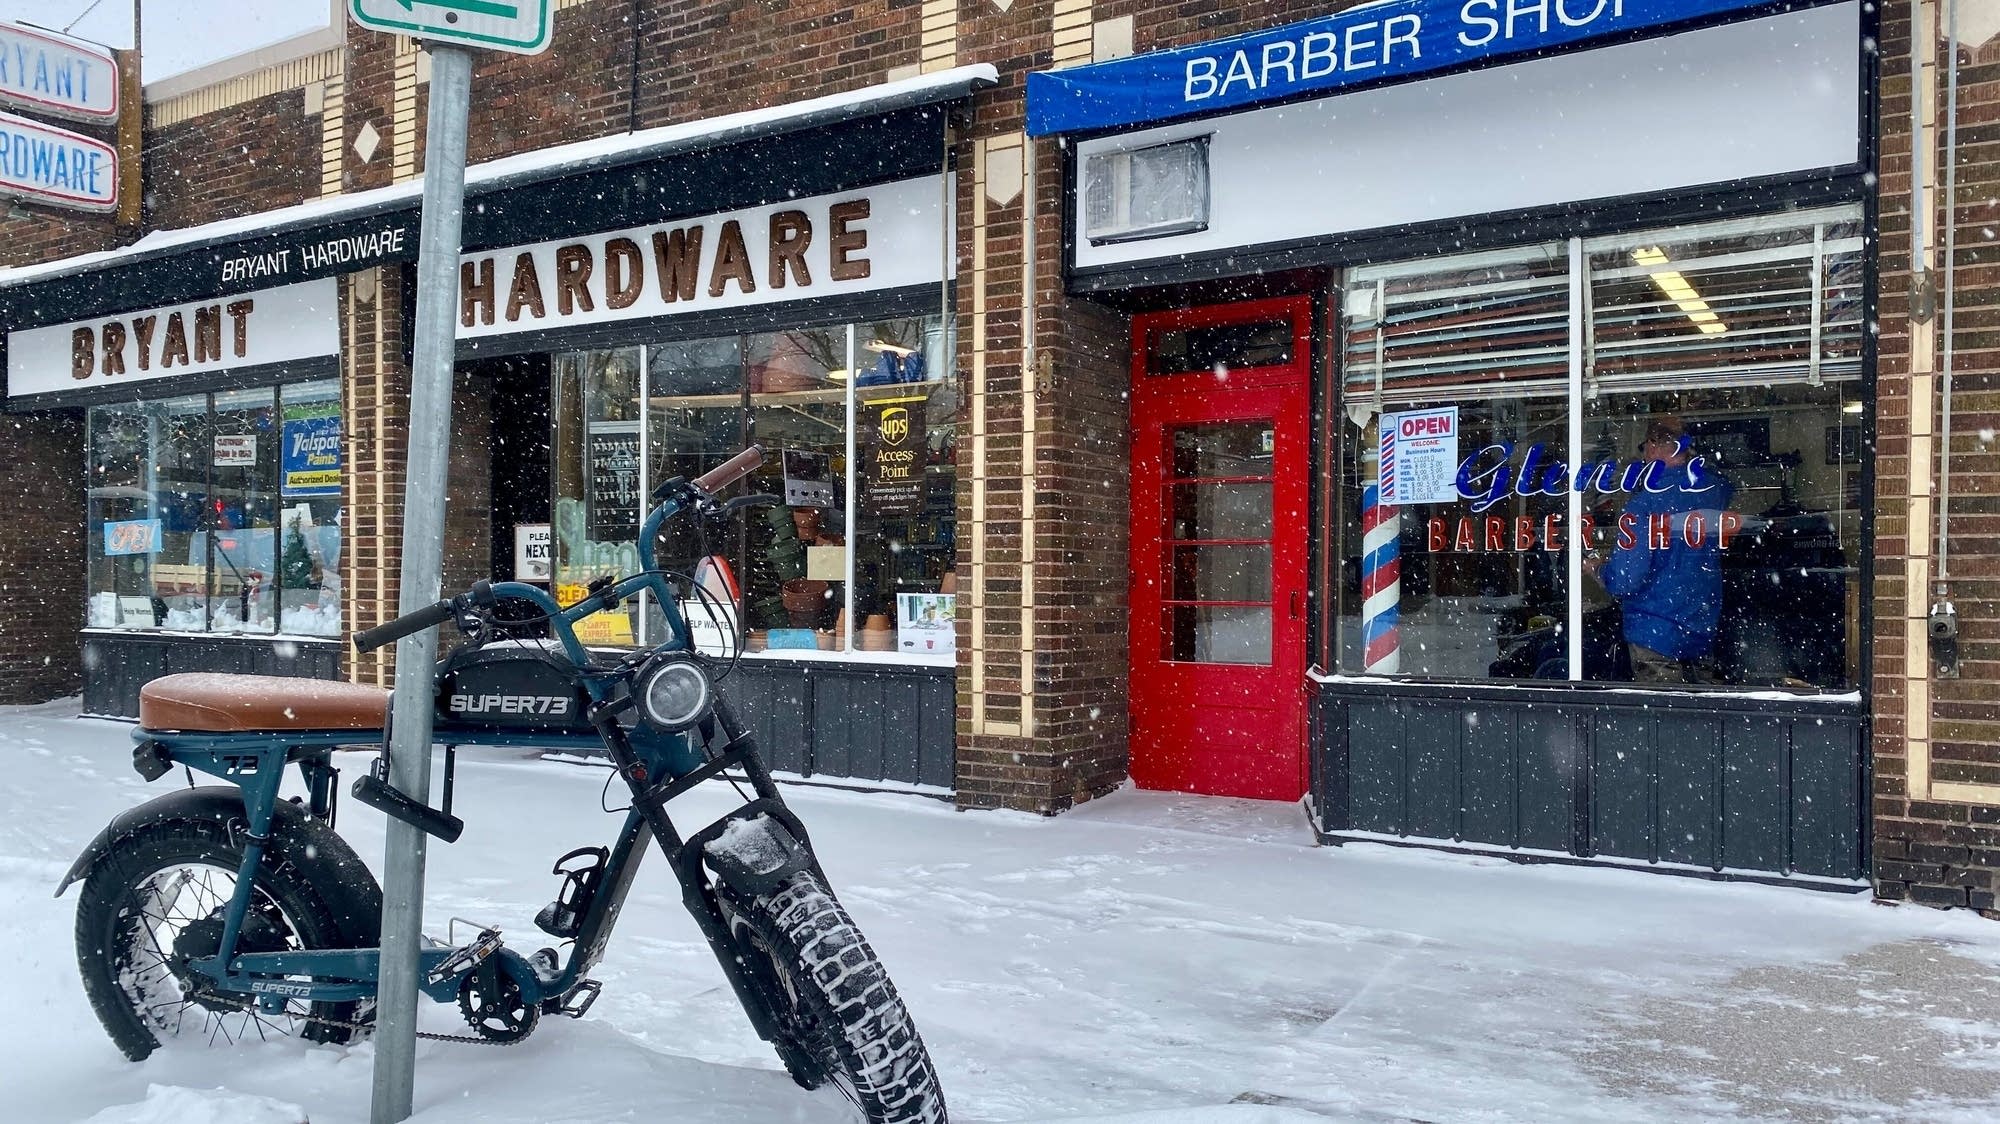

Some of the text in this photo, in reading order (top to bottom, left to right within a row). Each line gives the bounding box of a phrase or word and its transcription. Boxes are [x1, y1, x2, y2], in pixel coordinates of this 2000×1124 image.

[1185, 0, 1624, 101] BARBER SHO
[222, 228, 405, 281] BRYANT HARDWARE
[460, 199, 871, 327] HARDWARE
[71, 299, 254, 380] BRYANT
[883, 419, 906, 440] ups
[1402, 416, 1451, 437] OPEN
[292, 432, 341, 458] Valspar
[307, 453, 337, 466] Paints
[876, 450, 914, 463] Access
[289, 475, 324, 485] Authorized
[880, 465, 910, 478] Point
[1455, 434, 1715, 513] Glenn's
[1428, 511, 1743, 552] BARBER SHOP
[689, 619, 703, 628] ELP
[450, 694, 569, 714] SUPER73
[222, 755, 258, 775] 73
[251, 982, 312, 996] SUPER73
